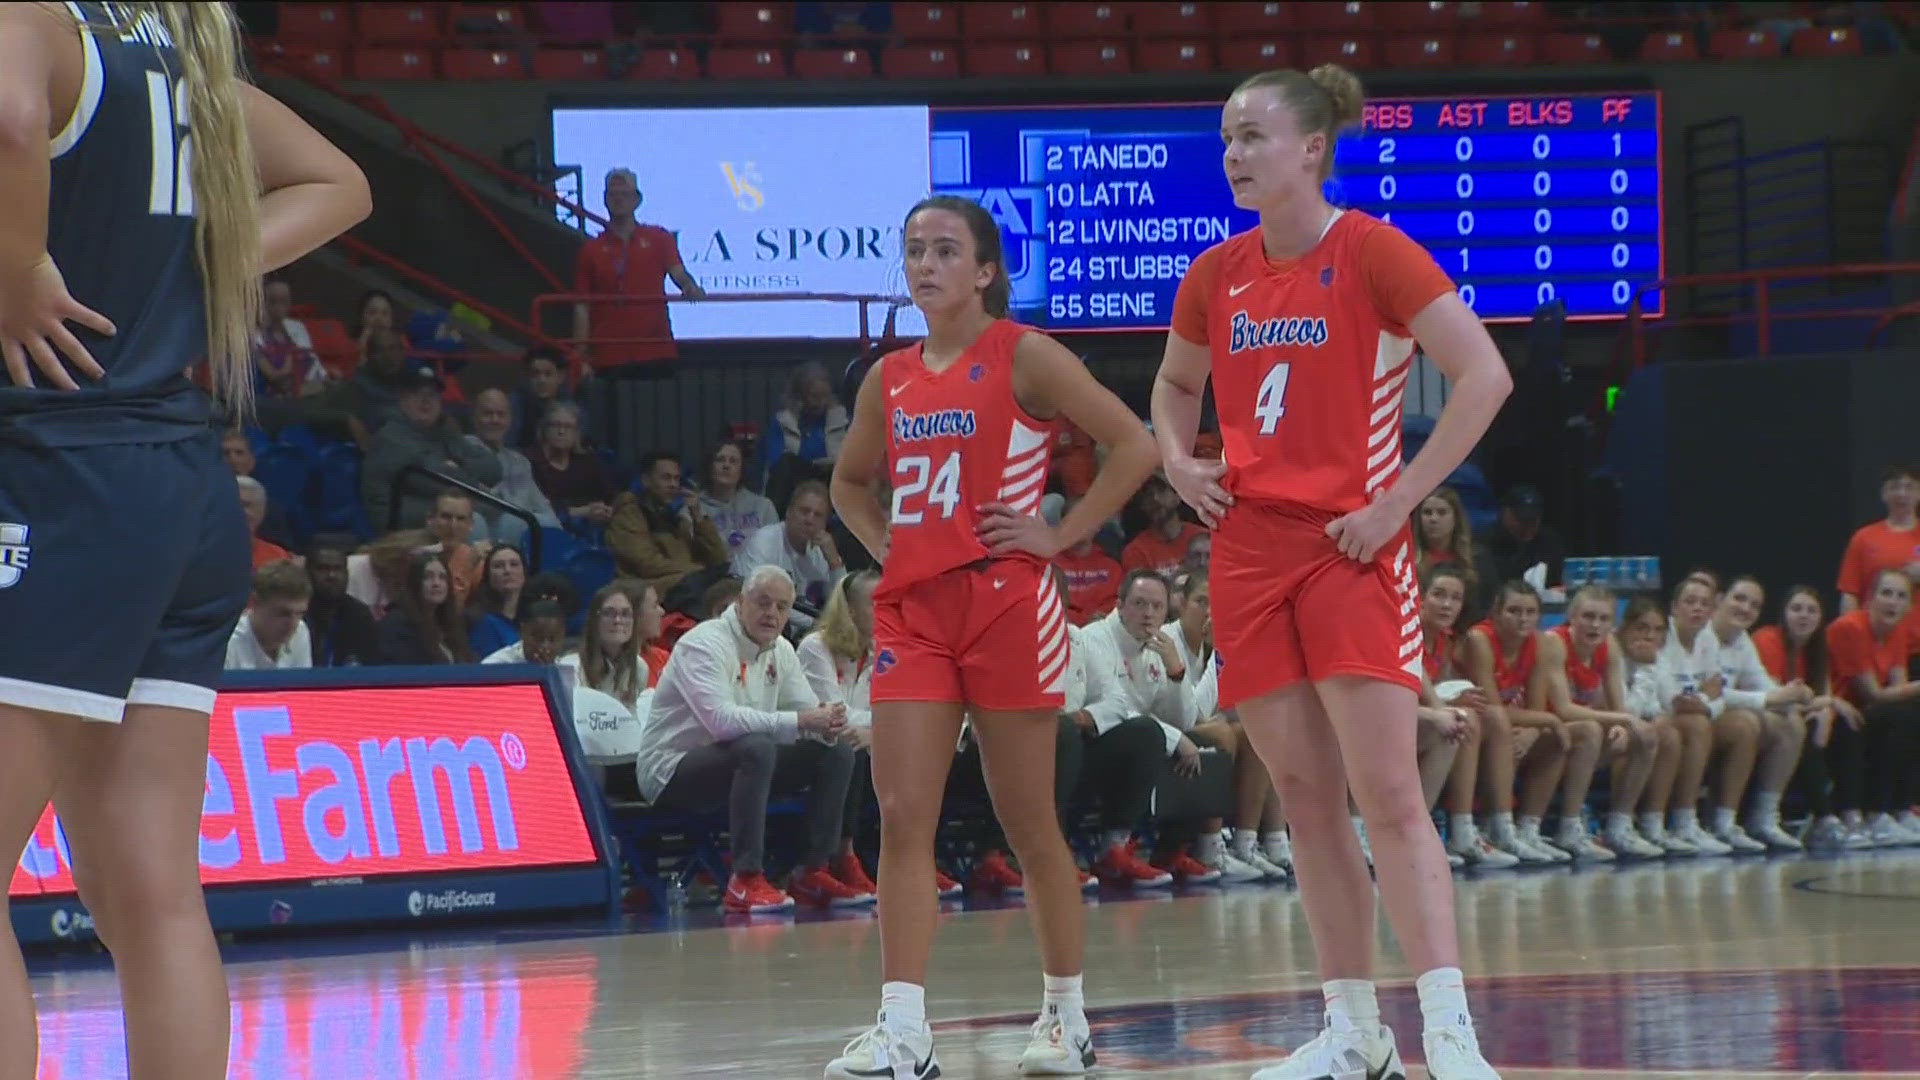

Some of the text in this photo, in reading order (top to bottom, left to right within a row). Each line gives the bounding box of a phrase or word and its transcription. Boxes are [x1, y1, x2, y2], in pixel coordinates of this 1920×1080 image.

[1362, 99, 1633, 130] RBS AST BLKS PF
[1046, 143, 1168, 171] 2 TANEDO
[1378, 132, 1622, 163] 2 0 0 1
[720, 160, 764, 211] VS
[1046, 181, 1155, 208] 10 LATTA
[1379, 169, 1629, 200] 0 0 0 0
[1047, 217, 1230, 245] 12 LIVINGSTON
[1457, 206, 1629, 235] 0 0 0
[755, 225, 904, 261] SPOR
[1049, 254, 1190, 282] 24 STUBBS
[1459, 243, 1630, 272] 1 0 0
[699, 273, 801, 289] FITNESS
[1612, 280, 1631, 305] 0
[1050, 293, 1156, 318] 55 SENE
[1254, 361, 1291, 436] 4
[891, 450, 962, 525] 24
[588, 710, 619, 731] Ford
[427, 891, 496, 912] PacificSource
